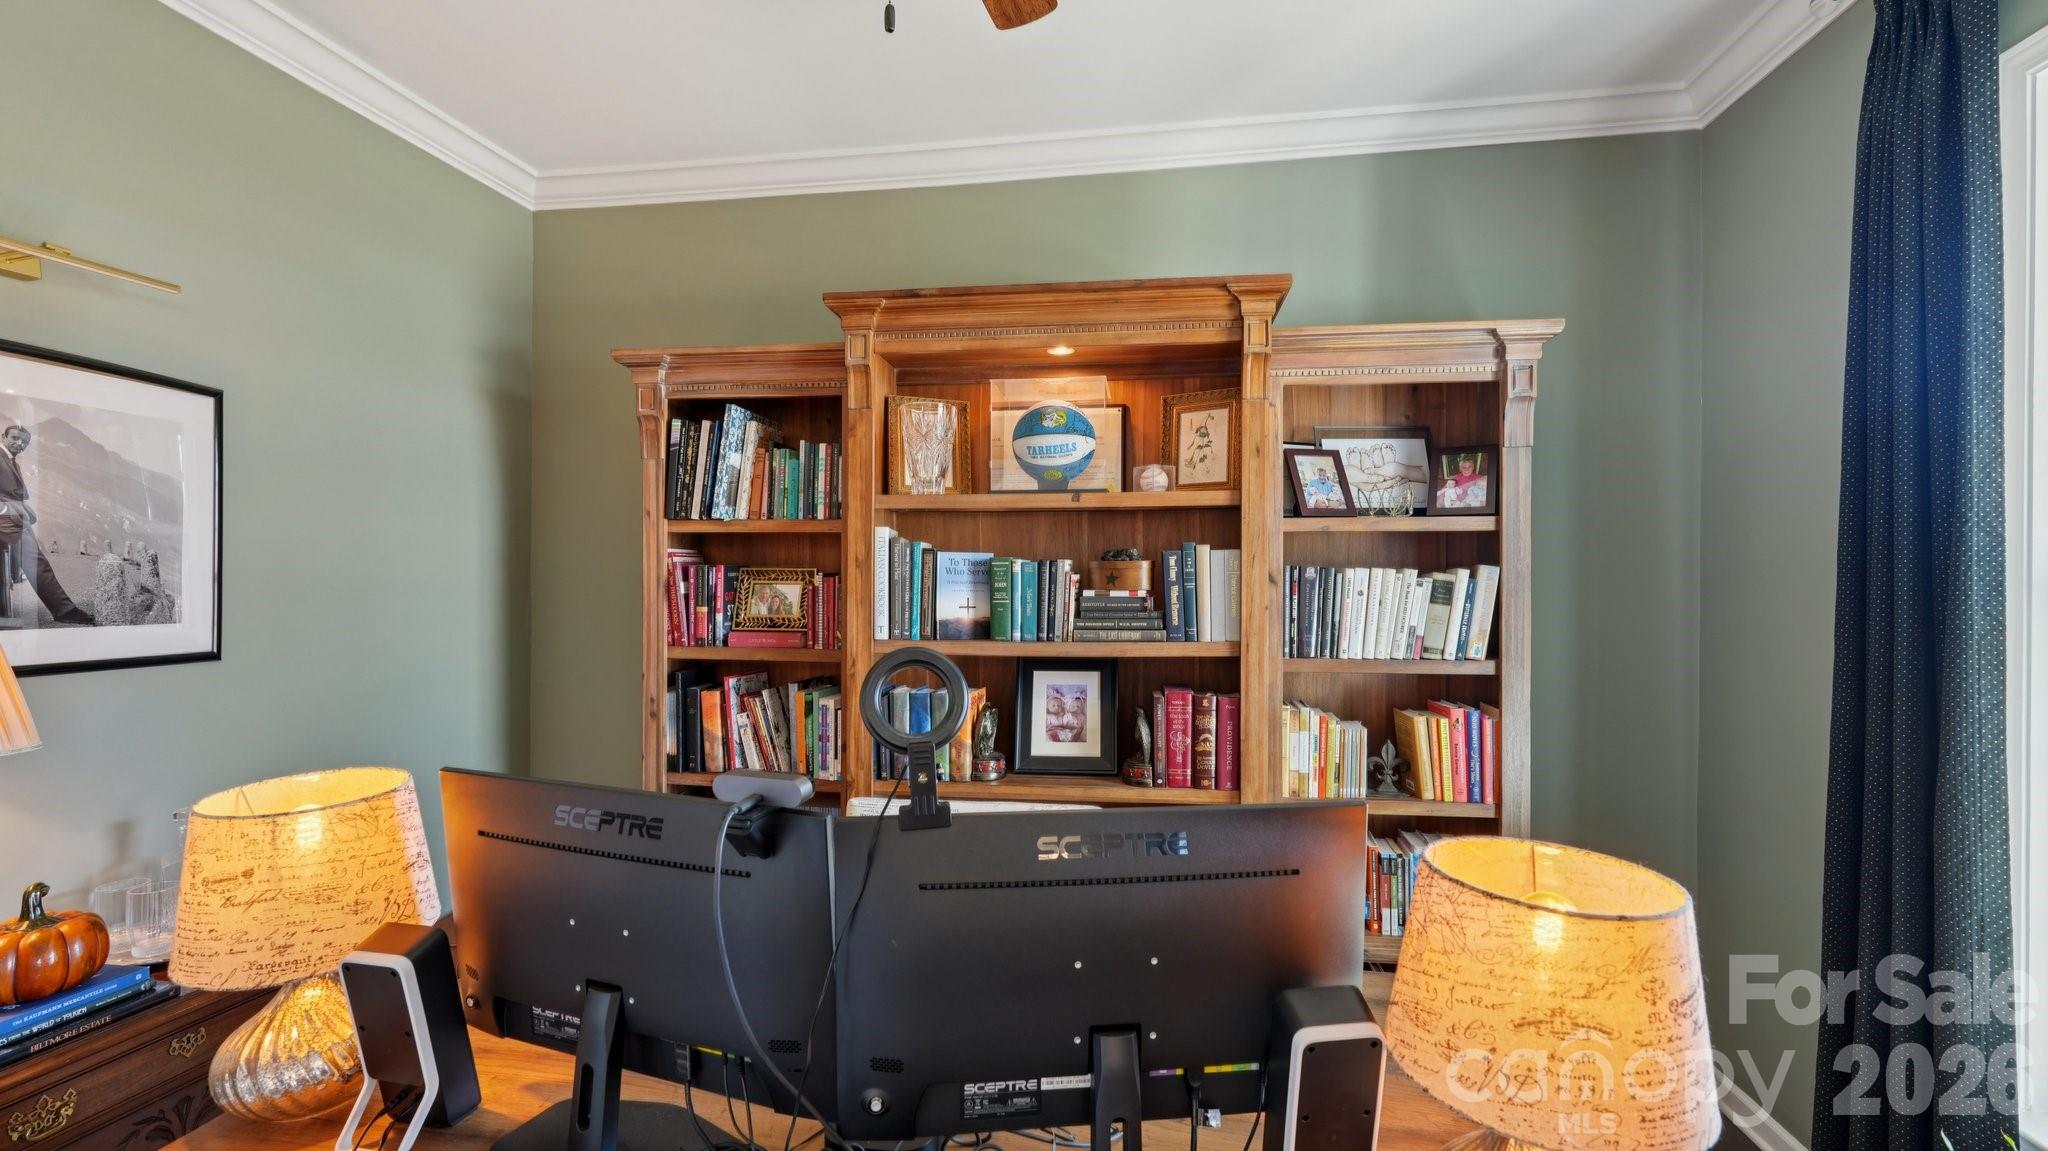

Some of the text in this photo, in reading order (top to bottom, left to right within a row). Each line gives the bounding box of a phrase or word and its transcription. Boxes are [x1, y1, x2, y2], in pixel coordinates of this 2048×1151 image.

[1026, 441, 1077, 456] TARHEELS
[945, 567, 964, 576] Who
[948, 558, 987, 567] To Those
[1168, 555, 1178, 581] Tom Clancy
[878, 536, 886, 617] ITALIAN COOKBOOK
[1170, 585, 1180, 604] Without
[1171, 604, 1180, 626] Remorse
[554, 804, 664, 840] SCEPTRE
[1036, 831, 1189, 861] SCEPTRE
[23, 1004, 63, 1023] KAUFMANN
[63, 988, 104, 1008] MERCANTILE
[32, 1019, 55, 1033] WORLD
[62, 1006, 87, 1020] TOLKIEN
[30, 1028, 78, 1053] BILTMORE
[79, 1015, 112, 1034] ESTATE
[964, 1079, 1038, 1095] SCEPTRE
